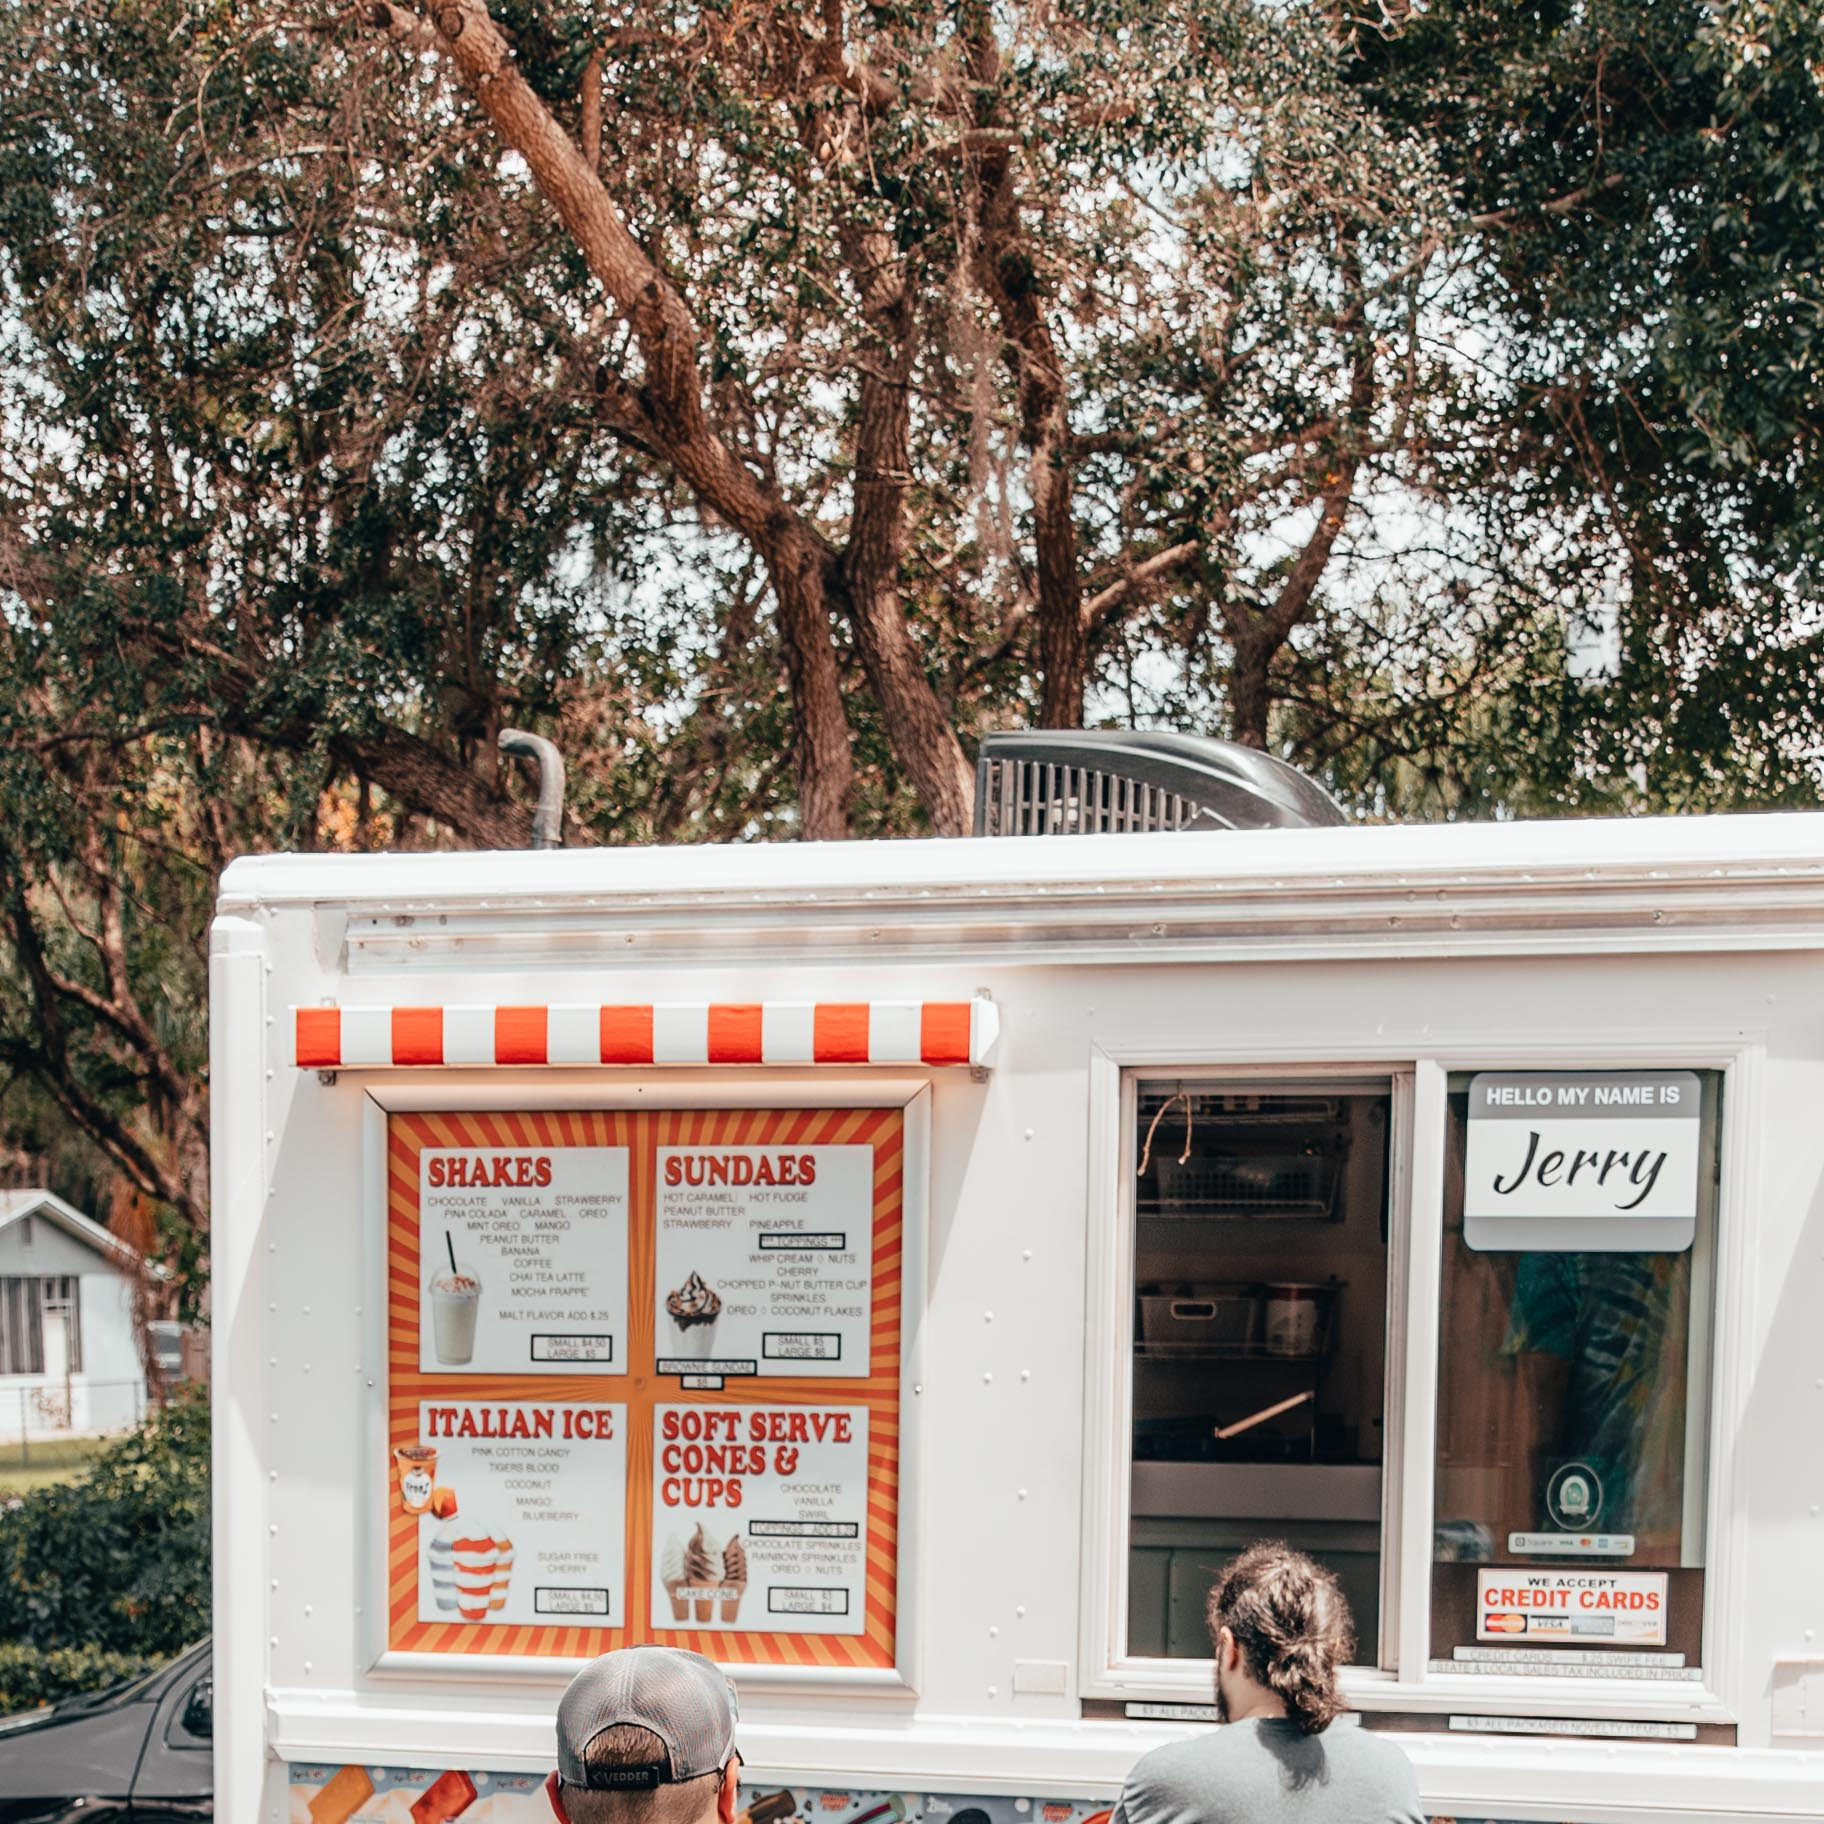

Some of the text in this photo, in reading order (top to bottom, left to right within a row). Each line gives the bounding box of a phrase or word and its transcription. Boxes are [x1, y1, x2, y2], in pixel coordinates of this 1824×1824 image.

[1486, 1086, 1680, 1106] HELLO MY NAME IS
[429, 1157, 552, 1187] SHAKES
[664, 1155, 816, 1186] SUNDAES
[1493, 1131, 1667, 1210] Jerry
[428, 1196, 623, 1207] CHOCOLATE VANILLA STRAWBERRY
[664, 1192, 808, 1202] HOT CARAMEL HOT FUDGE
[444, 1209, 607, 1218] PINA COLADA CARAMEL OREO
[664, 1207, 745, 1216] PEANUT BUTTER
[468, 1222, 570, 1230] MINT OREO MANGO
[663, 1220, 804, 1229] STRAWBERRY PINEAPPLE
[480, 1235, 559, 1244] PEANUT BUTTER
[776, 1237, 827, 1246] TOPPINGS
[501, 1247, 540, 1256] BANANA
[749, 1255, 855, 1263] WHIP CREAM NUTS
[514, 1259, 552, 1269] COFFEE
[777, 1267, 818, 1276] CHERRY
[510, 1273, 586, 1282] CHAI TEA LATTE
[717, 1280, 765, 1289] CHOPPED
[804, 1281, 843, 1289] BUTTER
[846, 1281, 867, 1289] CUP
[512, 1288, 546, 1296] MOCHA
[770, 1294, 826, 1303] SPRINKLES
[499, 1311, 524, 1320] MALT
[527, 1311, 565, 1320] FLAVOR
[568, 1311, 587, 1320] ADD
[727, 1306, 863, 1316] OREO COCONUT FLAKES
[548, 1339, 578, 1348] SMALL
[778, 1336, 808, 1345] SMALL
[547, 1350, 579, 1359] LARGE
[778, 1348, 811, 1357] LARGE
[428, 1408, 613, 1440] ITALIAN ICE
[662, 1411, 852, 1443] SOFT SERVE
[472, 1448, 570, 1457] PINK COTTON CANDY
[662, 1444, 799, 1476] CONES &
[490, 1463, 559, 1472] TIGERS BLOOD
[505, 1480, 551, 1488] COCONUT
[662, 1477, 742, 1508] CUPS
[780, 1484, 842, 1494] CHOCOLATE
[516, 1498, 551, 1506] MANGO
[794, 1497, 834, 1506] VANILLA
[523, 1512, 579, 1520] BLUEBERRY
[799, 1510, 829, 1520] SWIRL
[743, 1540, 861, 1550] CHOCOLATE SPRINKLES
[538, 1553, 599, 1562] SUGAR FREE
[752, 1552, 856, 1563] RAINBOW SPRINKLES
[547, 1564, 587, 1574] CHERRY
[771, 1565, 843, 1575] OREO NUTS
[1528, 1578, 1617, 1588] WE ACCEPT
[1484, 1588, 1659, 1611] CREDIT CARDS
[604, 1772, 649, 1784] VEDDER
